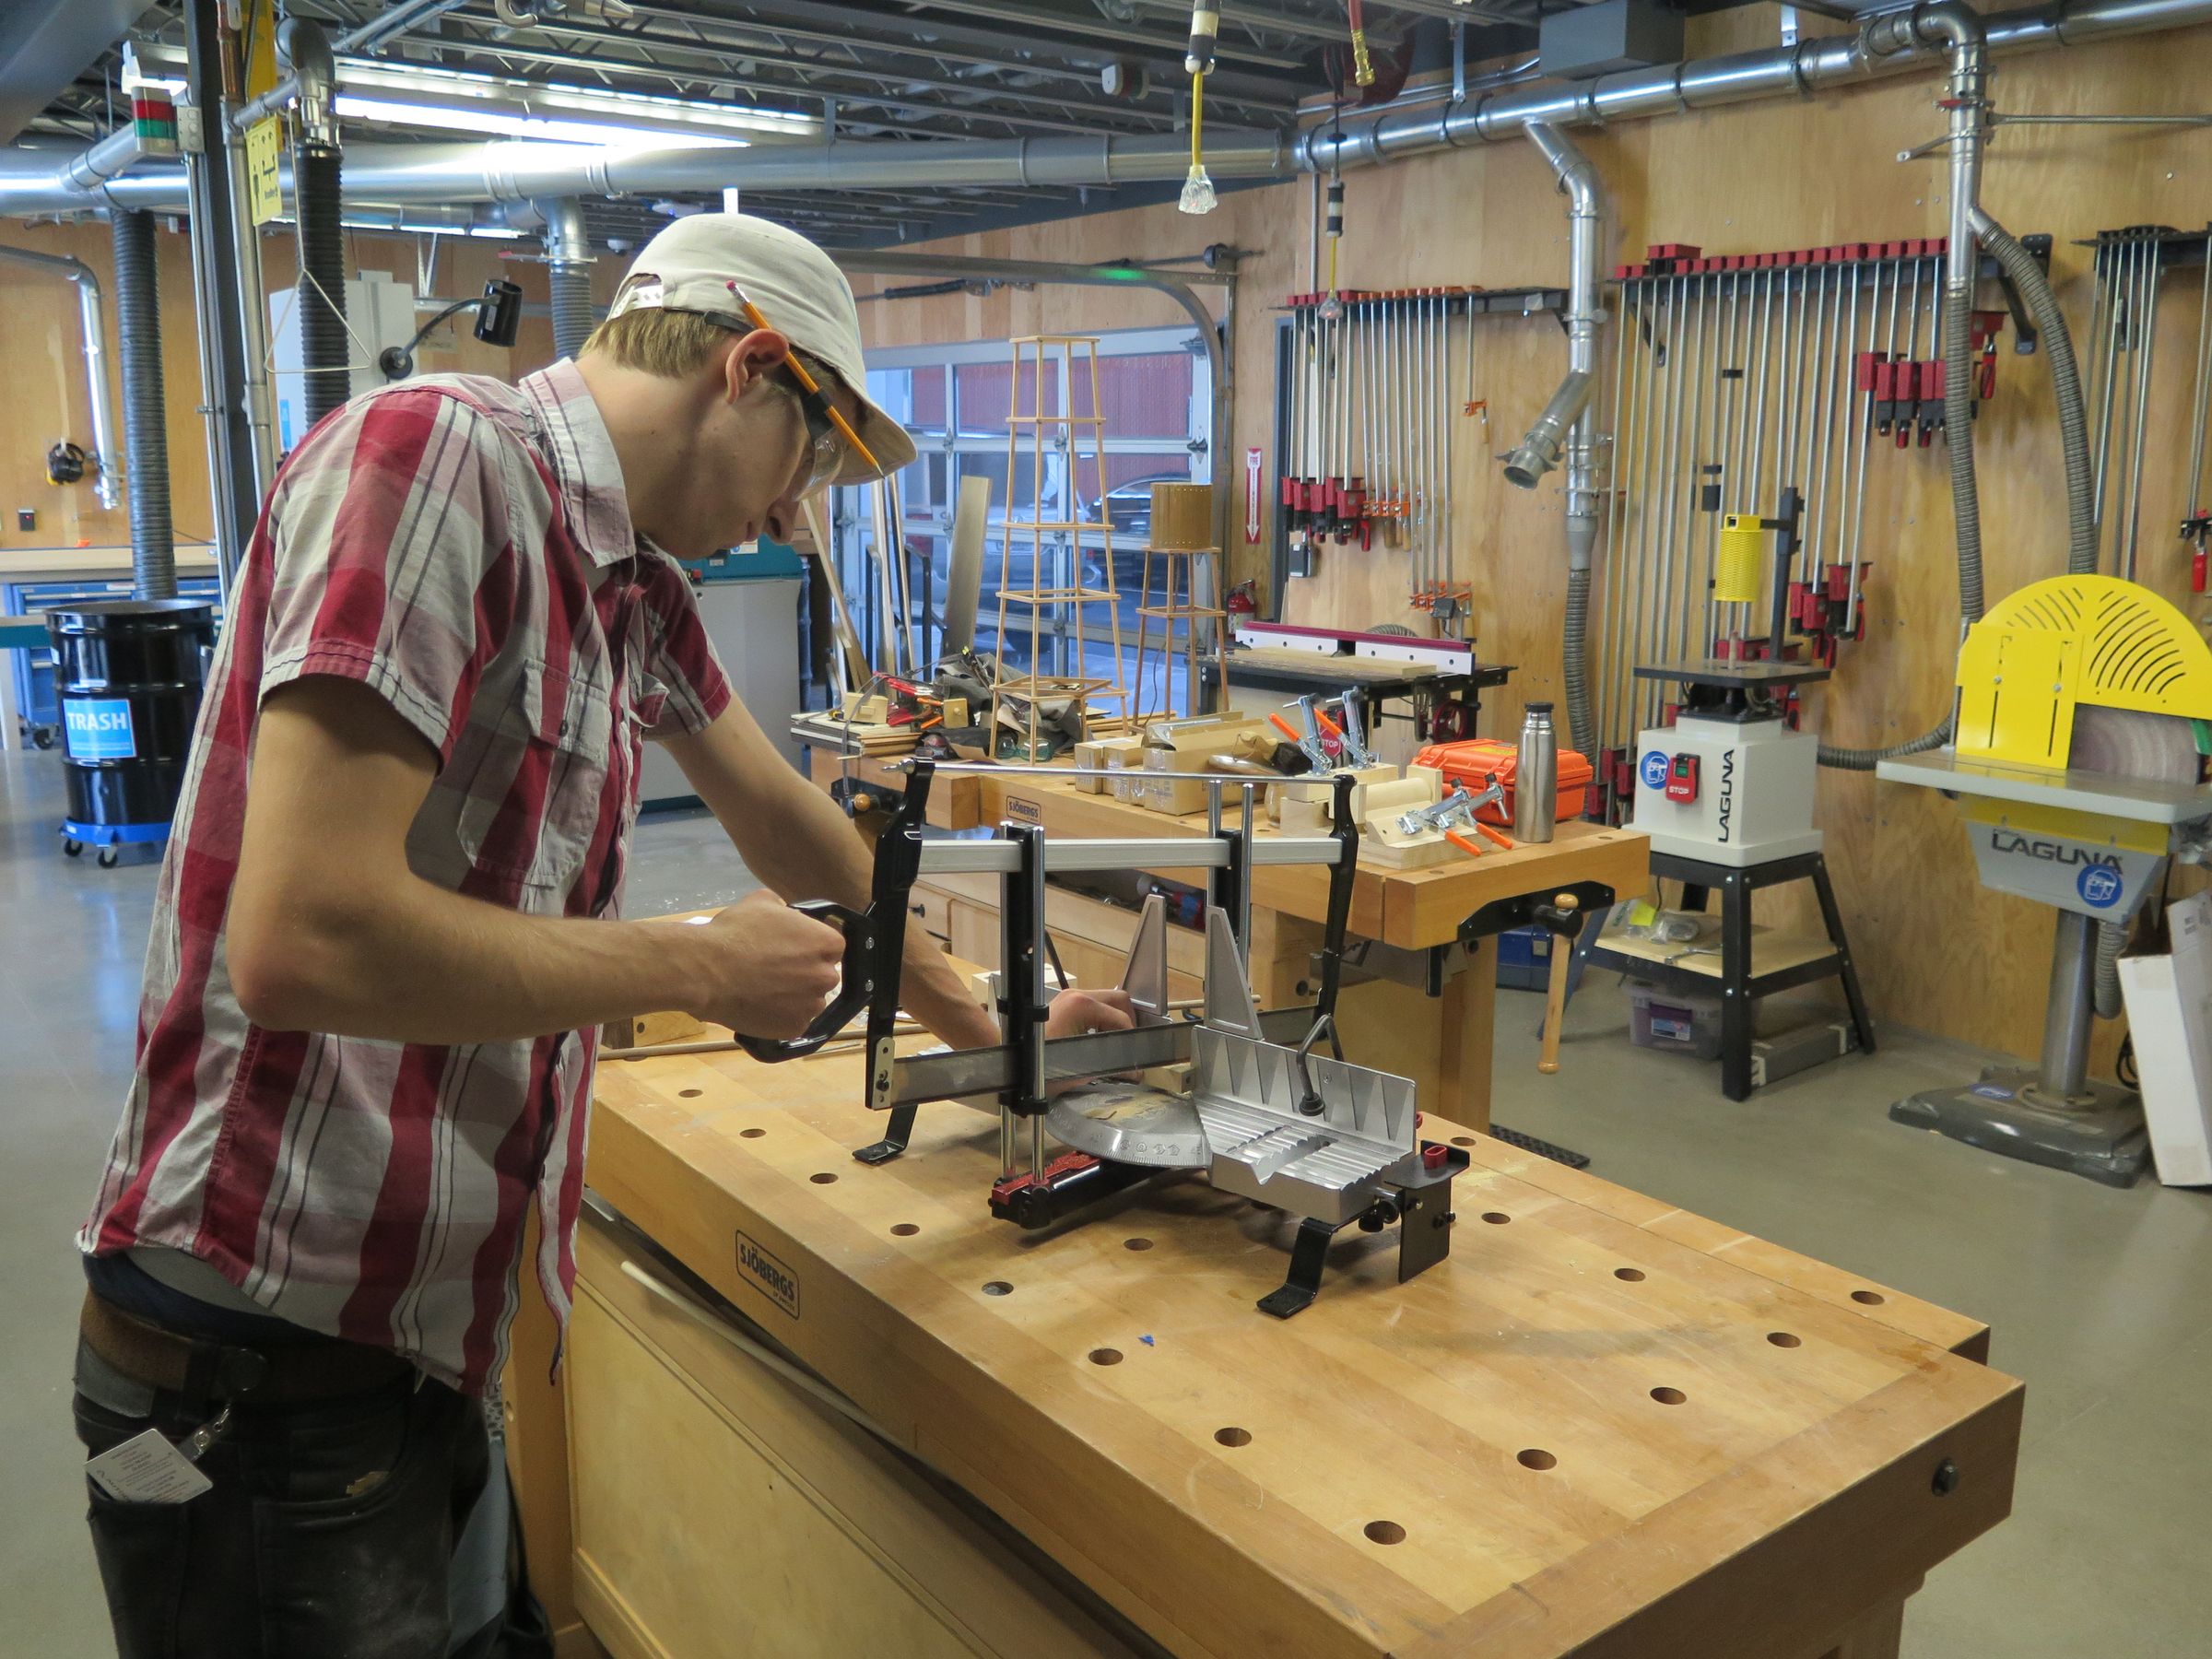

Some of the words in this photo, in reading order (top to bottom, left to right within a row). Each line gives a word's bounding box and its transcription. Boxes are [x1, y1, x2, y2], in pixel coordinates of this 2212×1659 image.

[67, 712, 128, 731] TRASH
[1324, 738, 1338, 748] TOP
[1669, 786, 1688, 794] STOP
[1718, 749, 1735, 842] LAGUNA
[740, 1243, 794, 1301] SJÖBERGS
